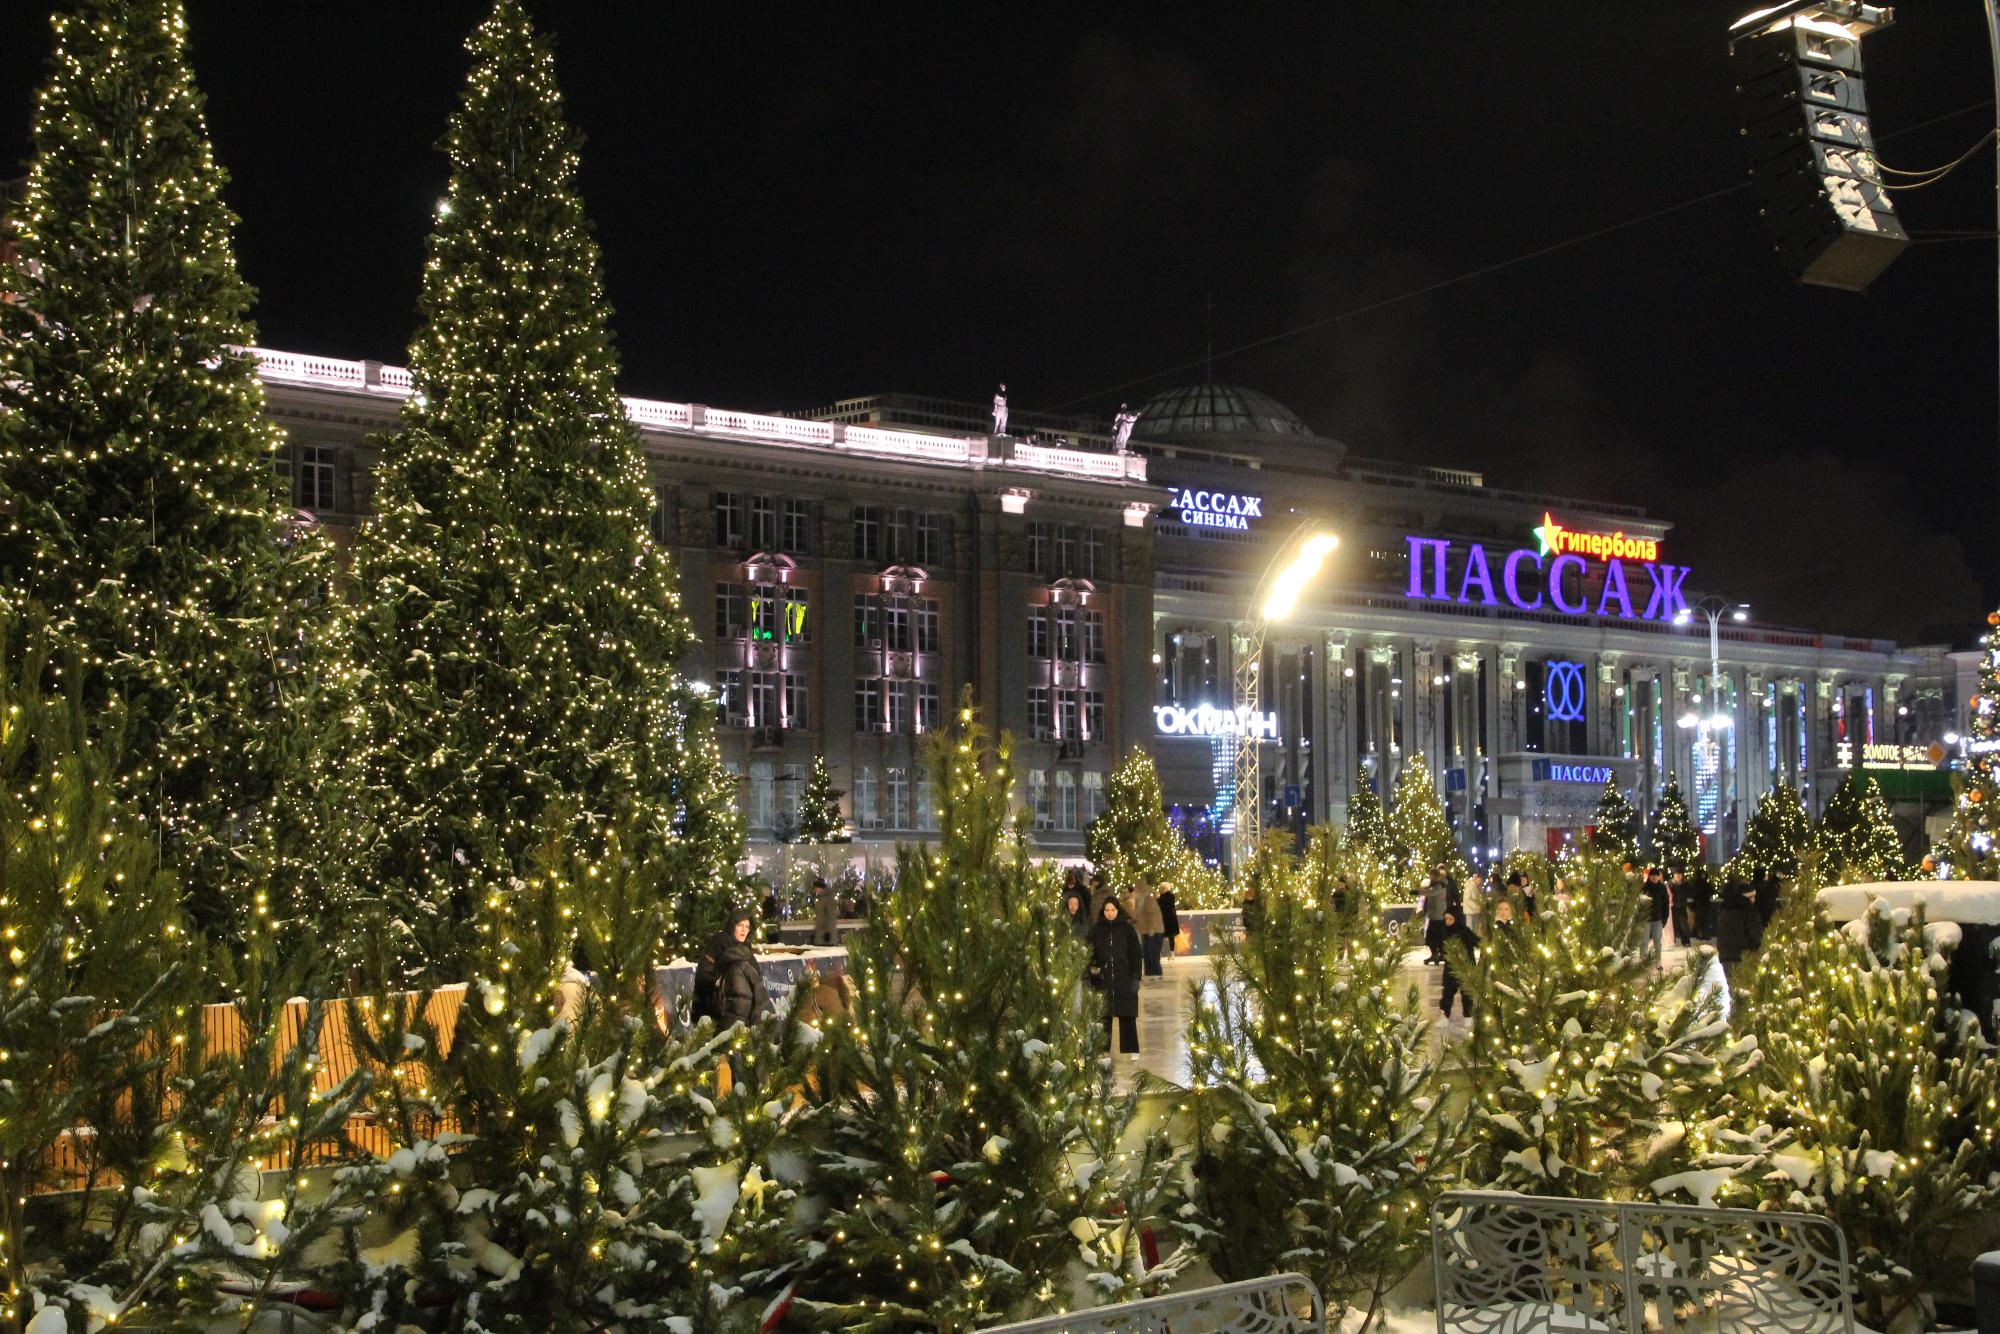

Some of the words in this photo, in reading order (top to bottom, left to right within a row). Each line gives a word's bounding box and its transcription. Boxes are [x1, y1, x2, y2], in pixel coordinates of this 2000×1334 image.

[1181, 509, 1249, 530] СИНЕМА
[1558, 532, 1657, 561] гипербола
[1405, 535, 1695, 624] ПАССАЖ
[1862, 743, 1900, 761] ЗОЛОТОЕ
[1551, 765, 1612, 783] ПАССАЖ
